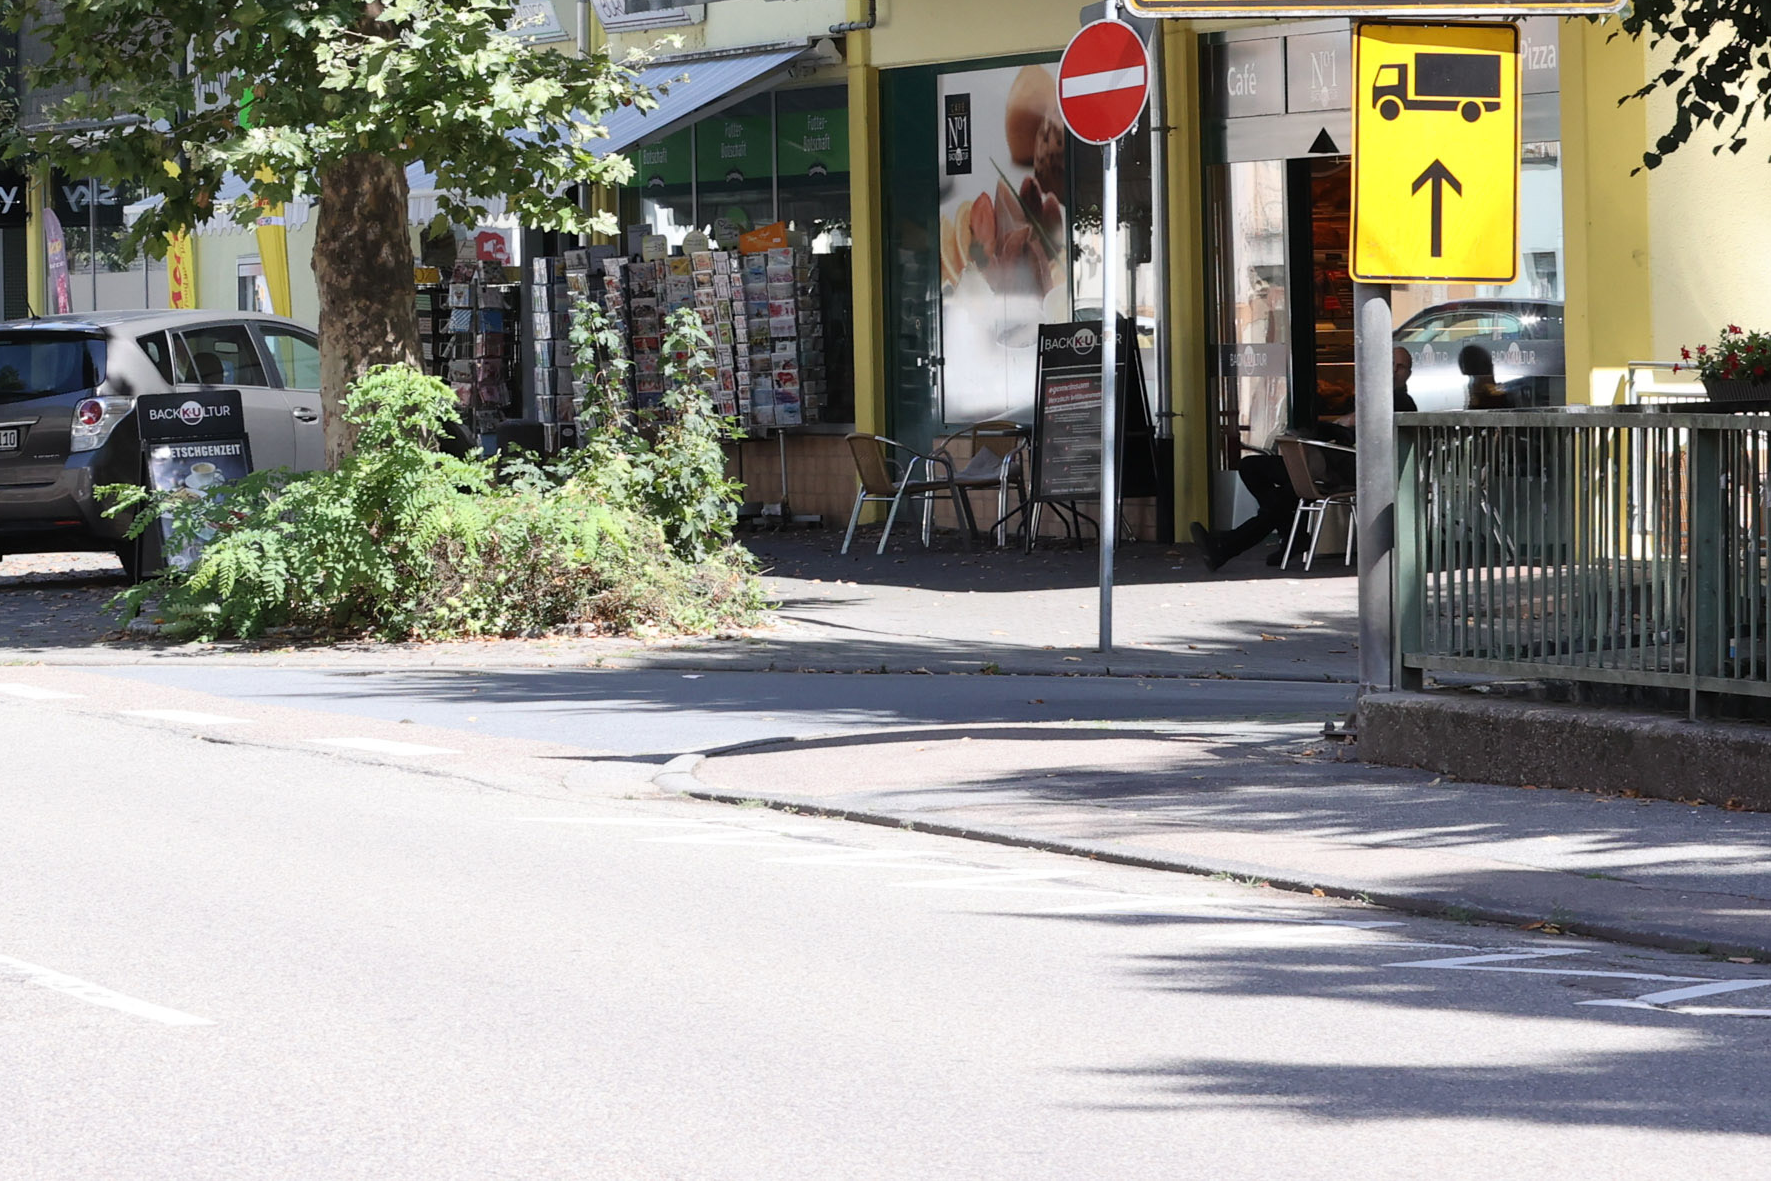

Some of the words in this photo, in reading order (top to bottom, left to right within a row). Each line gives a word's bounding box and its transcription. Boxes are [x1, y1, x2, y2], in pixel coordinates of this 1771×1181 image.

[1520, 36, 1556, 71] Pizza
[1227, 62, 1257, 97] Café
[151, 444, 241, 459] ETSCHGENZEIT
